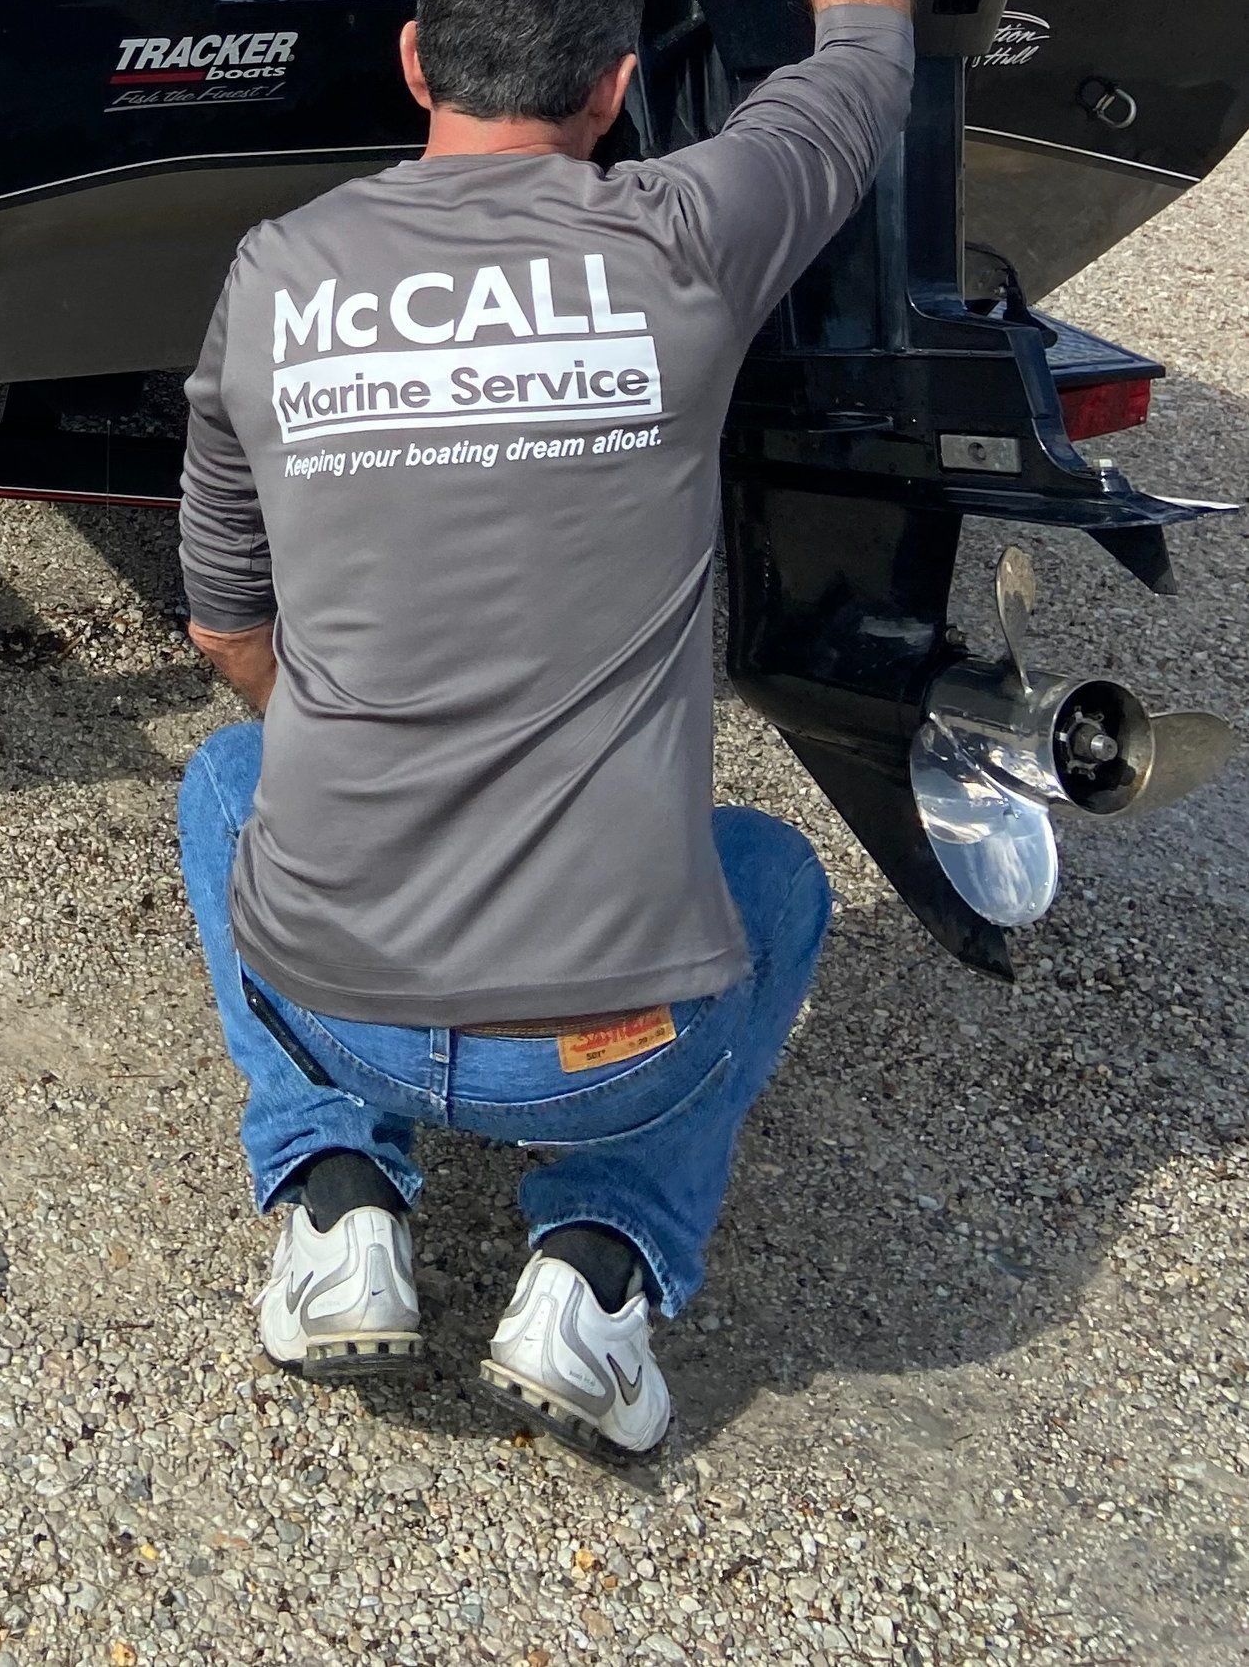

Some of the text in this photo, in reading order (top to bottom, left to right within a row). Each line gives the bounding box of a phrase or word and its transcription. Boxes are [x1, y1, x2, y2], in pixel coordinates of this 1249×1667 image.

[115, 31, 299, 71] TRACKER
[205, 66, 287, 81] boats
[112, 89, 161, 105] Fish
[163, 88, 196, 102] the
[272, 253, 648, 364] McCALL
[279, 360, 650, 423] Marine Service
[284, 424, 663, 480] Keeping your boating dream afloat.
